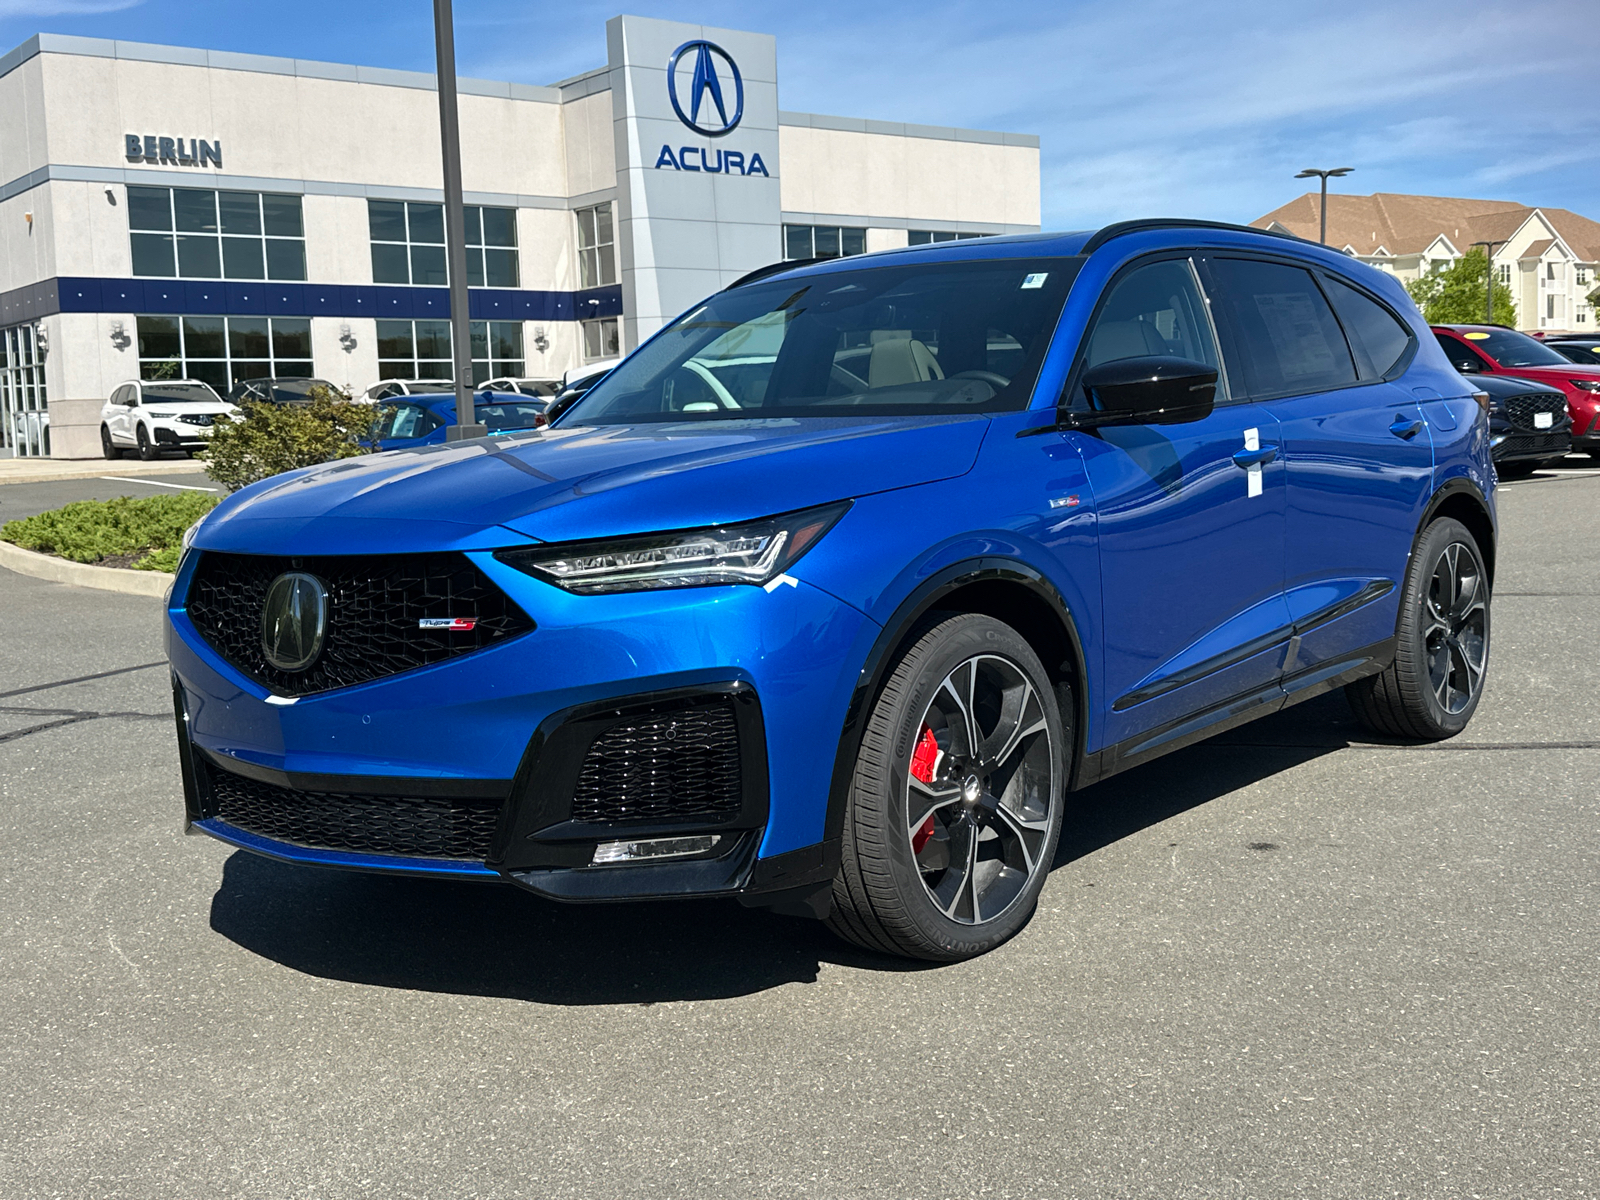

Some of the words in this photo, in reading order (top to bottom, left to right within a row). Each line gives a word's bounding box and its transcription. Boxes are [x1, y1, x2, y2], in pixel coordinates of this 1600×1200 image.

[125, 134, 222, 167] BERLIN
[655, 144, 769, 177] ACURA
[449, 617, 477, 631] S
[895, 688, 922, 759] Continental
